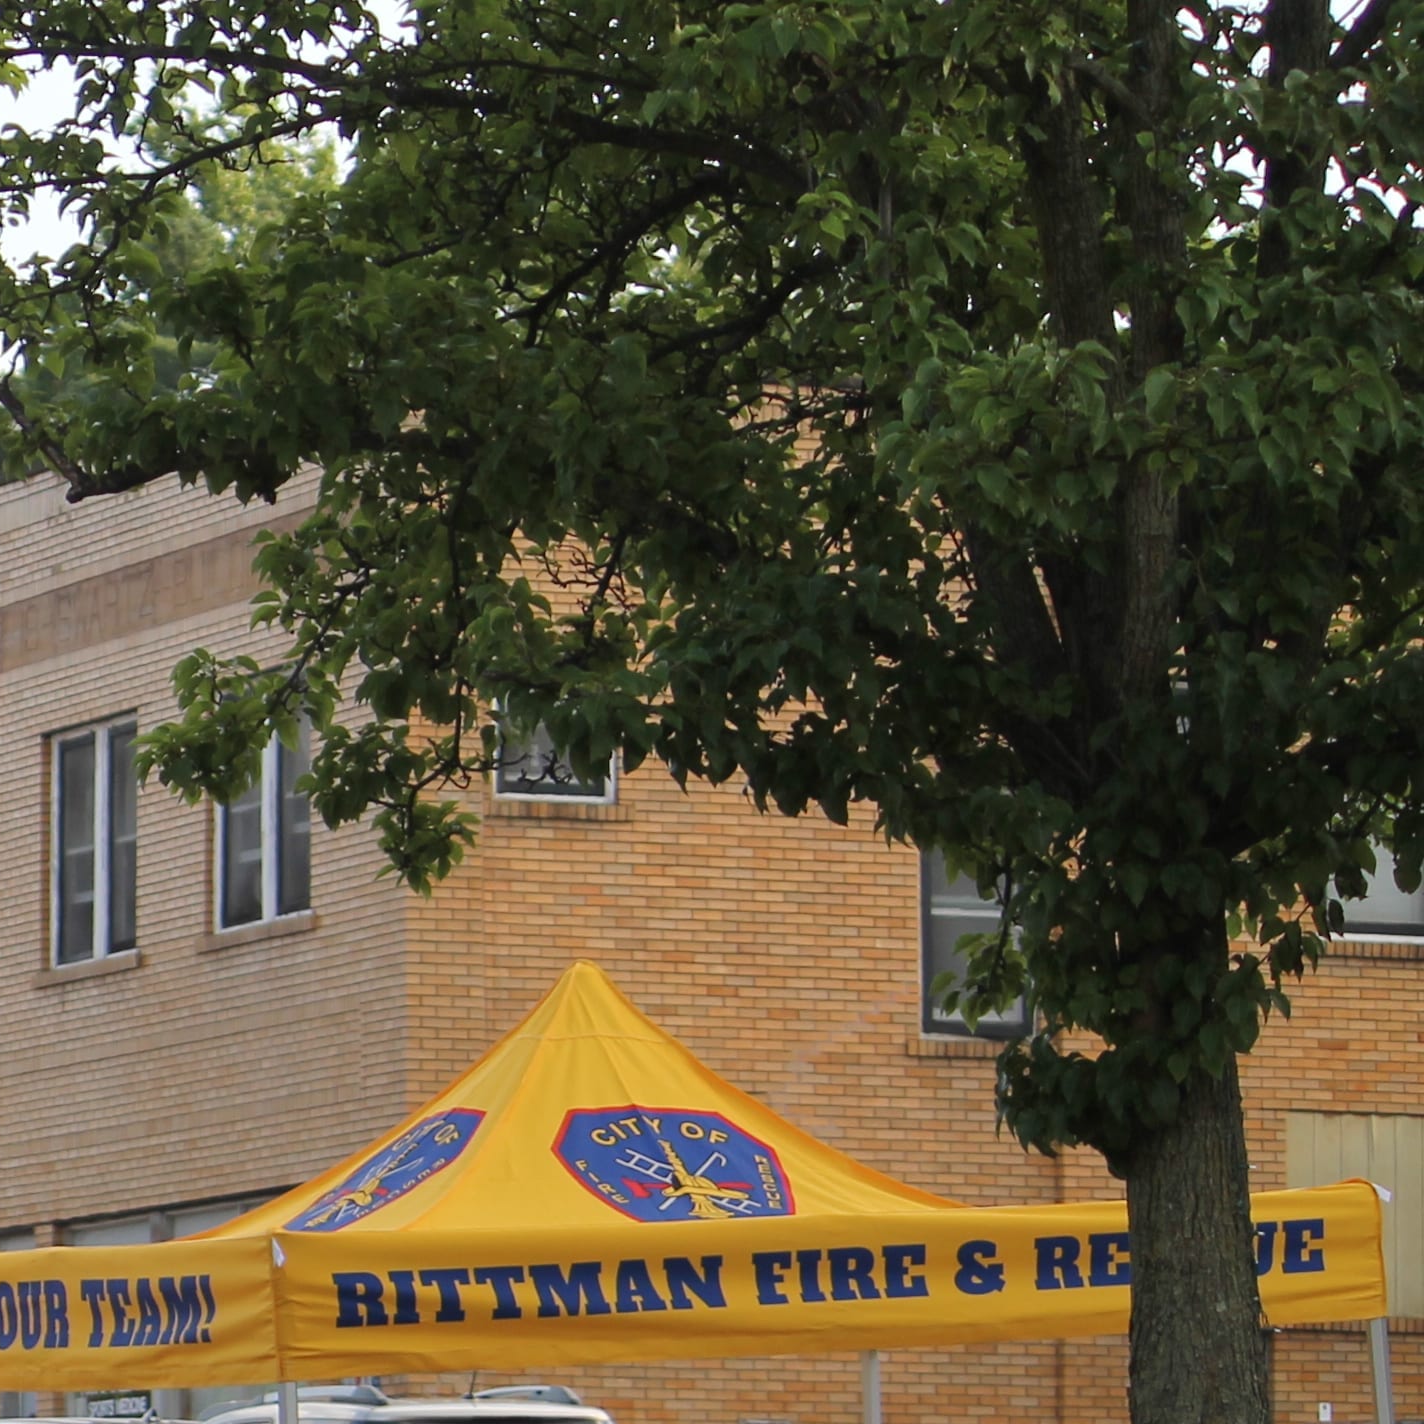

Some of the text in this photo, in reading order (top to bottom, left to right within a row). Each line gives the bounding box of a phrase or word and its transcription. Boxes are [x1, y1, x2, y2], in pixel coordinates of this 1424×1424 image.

[590, 1114, 729, 1146] CITY OF
[574, 1158, 630, 1205] FIRE
[753, 1153, 783, 1210] RESCUE
[331, 1218, 1326, 1329] RITTMAN FIRE & REE
[80, 1274, 217, 1348] TEAM!
